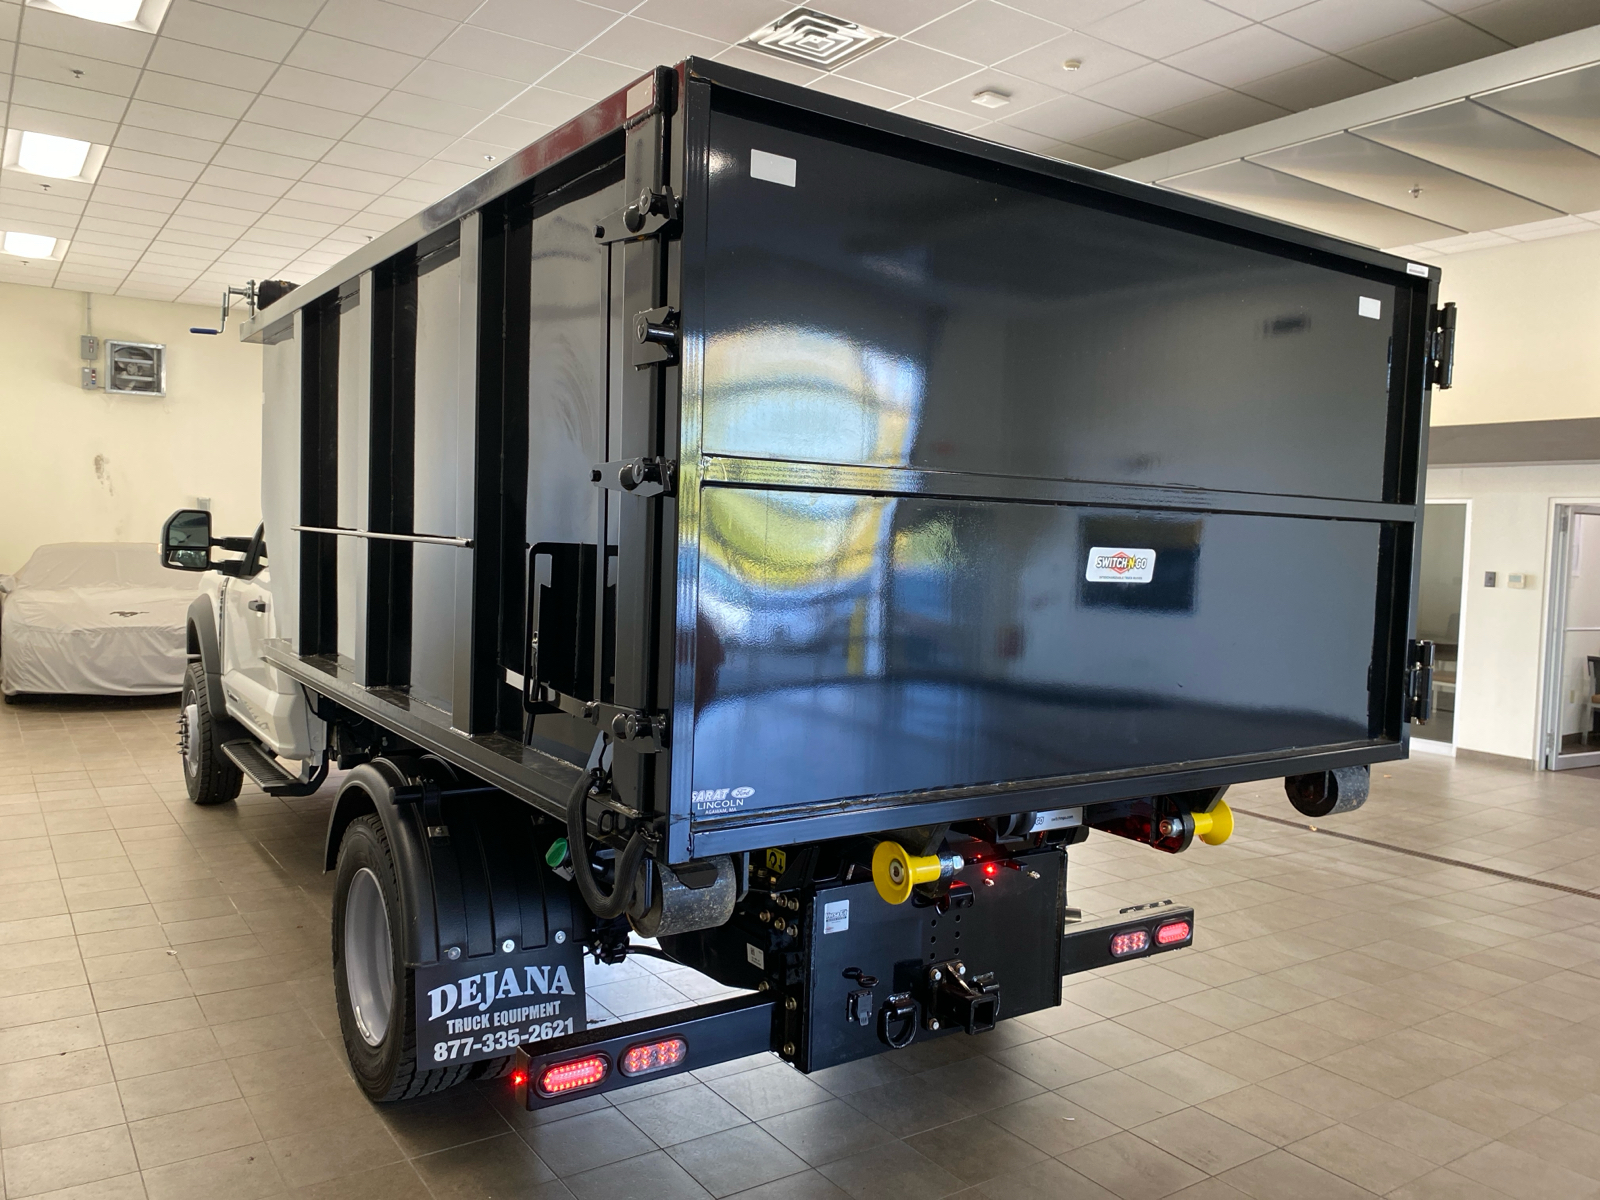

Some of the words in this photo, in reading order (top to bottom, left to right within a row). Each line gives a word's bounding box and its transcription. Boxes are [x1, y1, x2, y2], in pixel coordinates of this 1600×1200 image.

[697, 799, 744, 810] LINCOLN
[734, 787, 752, 797] Ford
[427, 965, 576, 1021] DEJANA
[447, 1016, 490, 1034] TRUCK
[493, 1000, 561, 1026] EQUIPMENT
[433, 1017, 574, 1062] 877-335-2621
